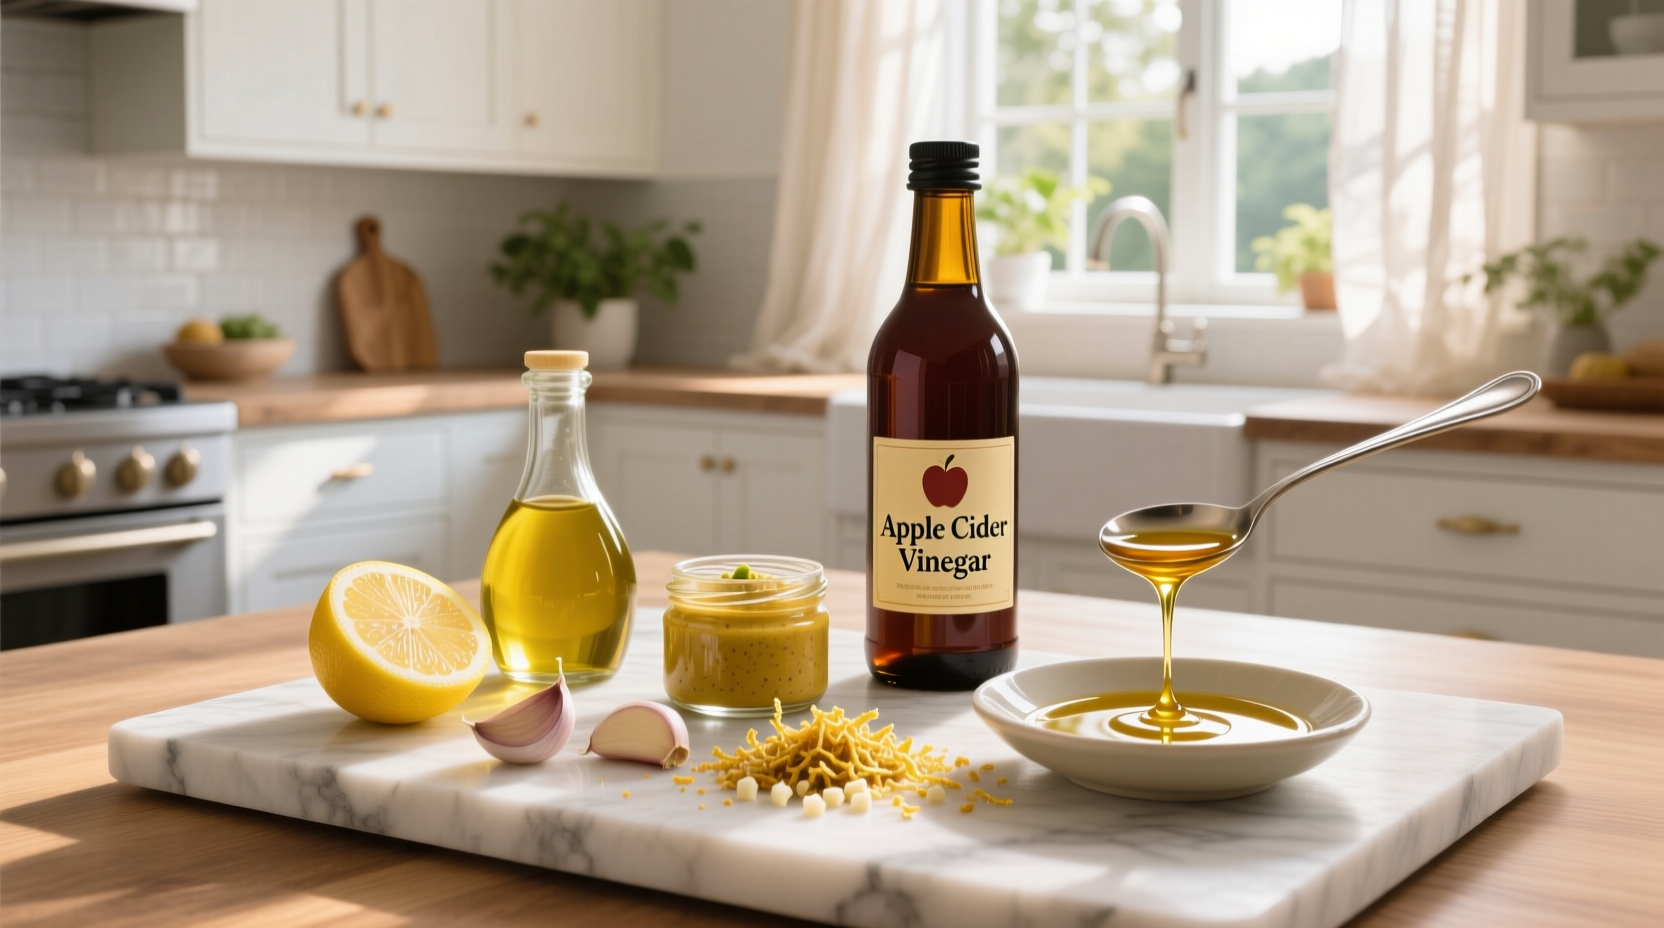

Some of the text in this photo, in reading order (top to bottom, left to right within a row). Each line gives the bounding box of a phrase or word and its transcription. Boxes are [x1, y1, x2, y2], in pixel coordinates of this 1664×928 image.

[880, 514, 1008, 546] Apple Cider
[898, 548, 991, 580] Vinegar
